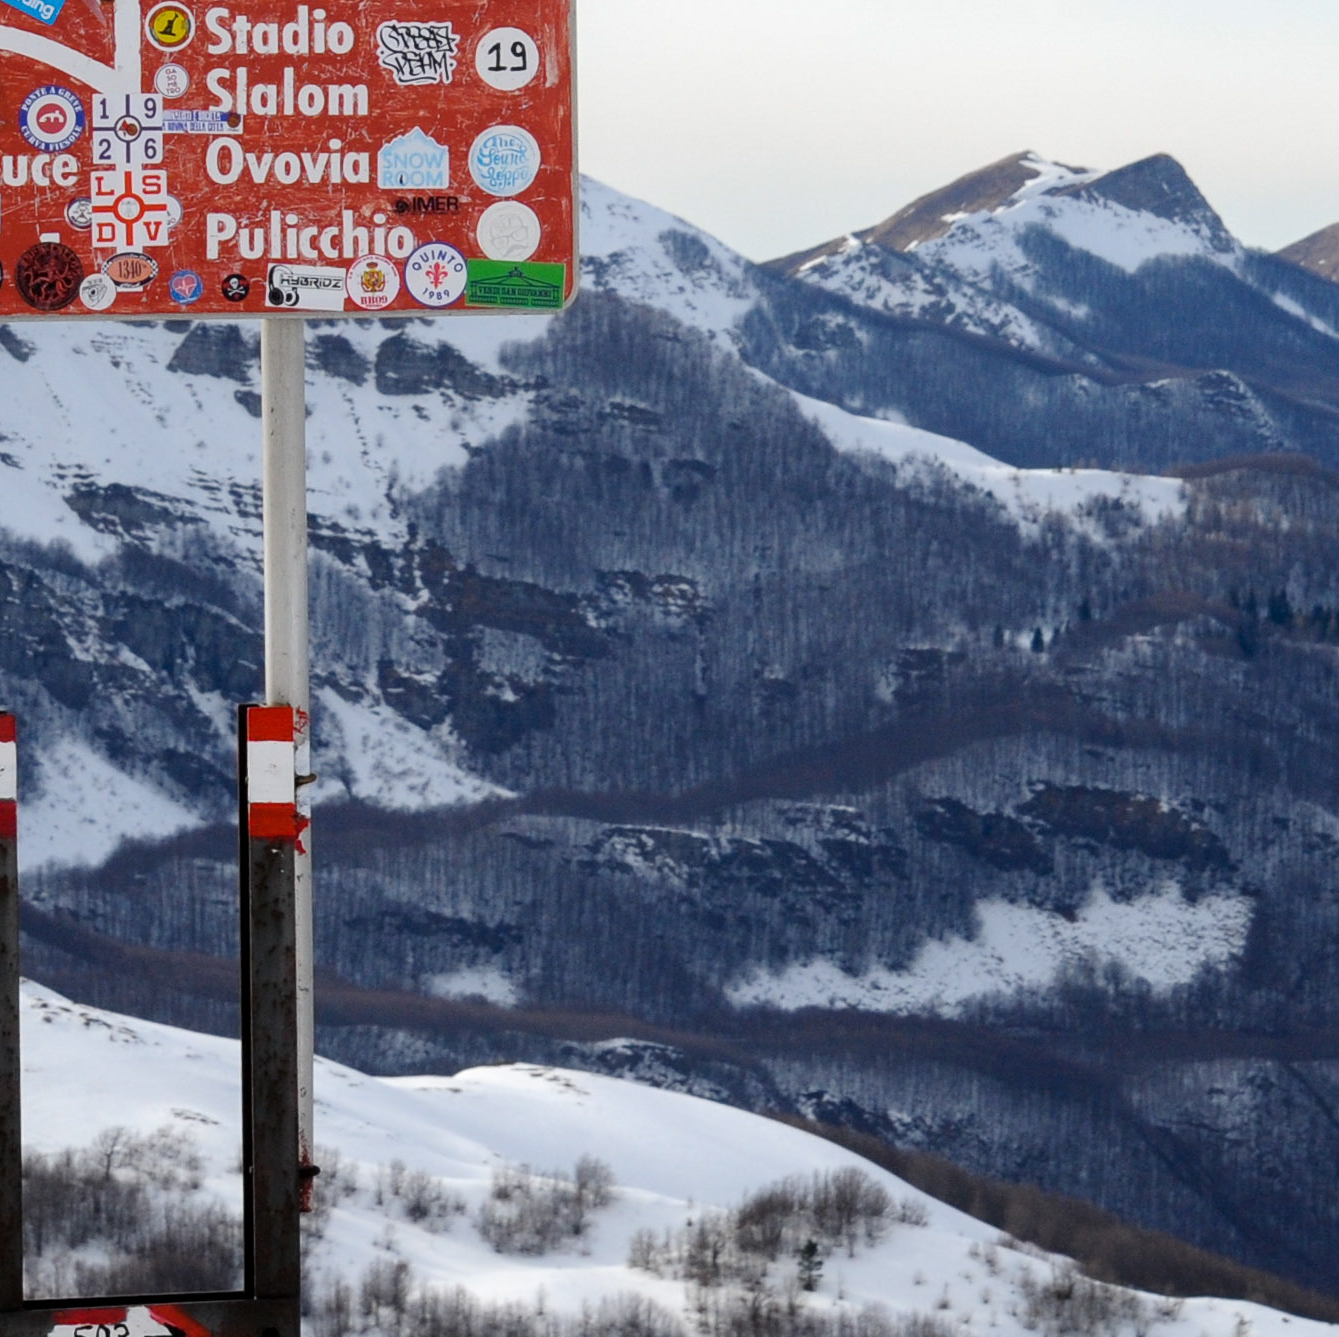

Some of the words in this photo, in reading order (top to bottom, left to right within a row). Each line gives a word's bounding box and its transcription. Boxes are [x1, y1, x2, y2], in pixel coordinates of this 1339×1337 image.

[205, 4, 355, 55] Stadio
[487, 40, 528, 72] 19
[21, 87, 47, 111] PONTE
[49, 86, 56, 95] A
[58, 88, 83, 112] GREVE
[206, 66, 368, 115] Slalom
[21, 125, 46, 150] CURVA
[206, 137, 370, 185] Ovovia
[382, 152, 444, 169] SNOW
[383, 170, 443, 186] ROOM
[412, 196, 460, 212] IMER
[206, 210, 414, 260] Pulicchio
[411, 249, 464, 273] QUINTO
[422, 287, 451, 301] 1989
